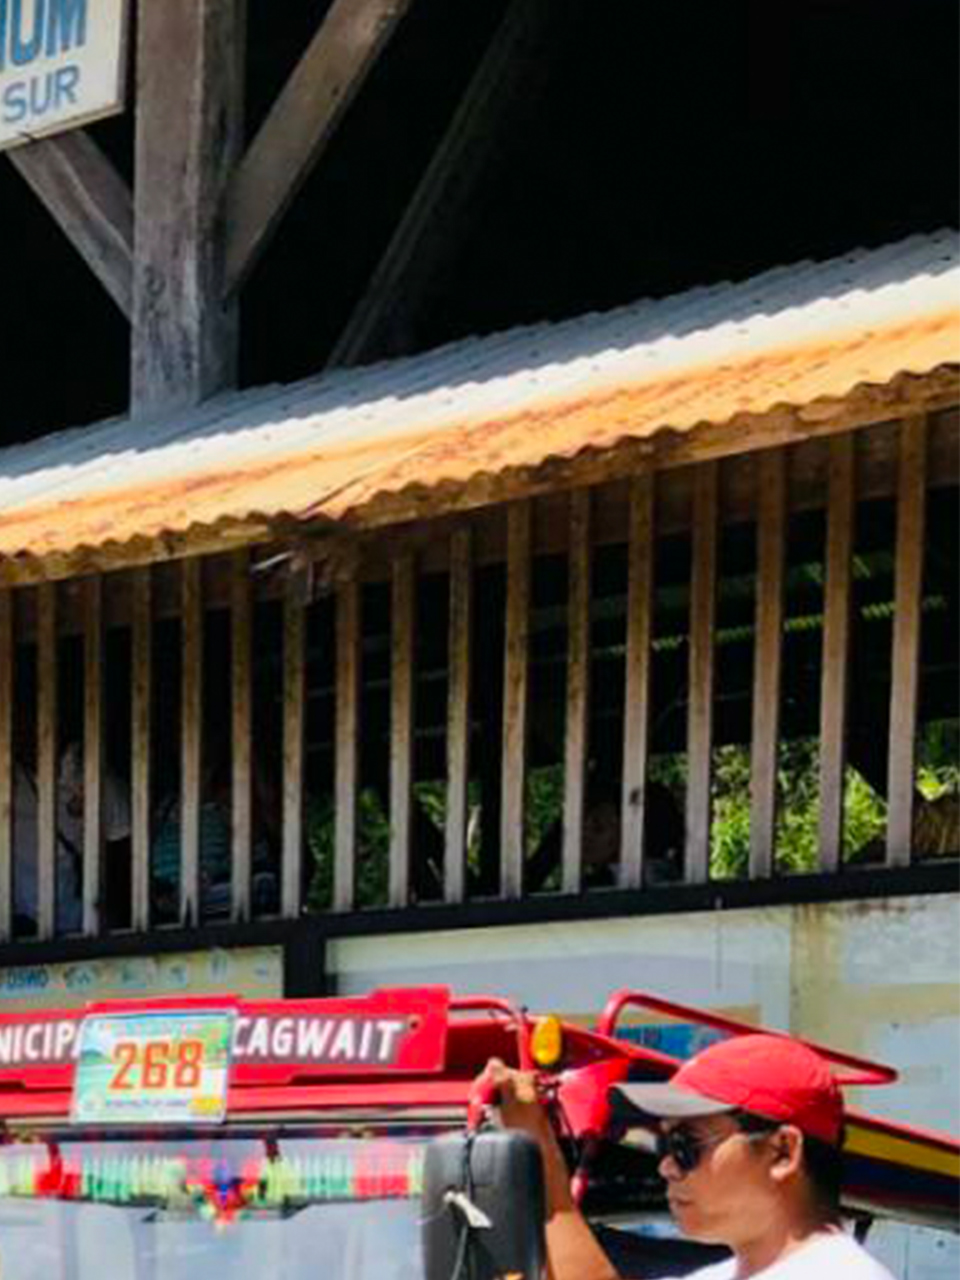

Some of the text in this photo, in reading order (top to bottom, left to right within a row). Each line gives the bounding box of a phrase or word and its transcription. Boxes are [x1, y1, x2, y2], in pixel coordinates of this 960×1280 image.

[2, 64, 81, 124] SUR
[108, 1038, 204, 1090] 268
[231, 1017, 403, 1061] CAGWAIT
